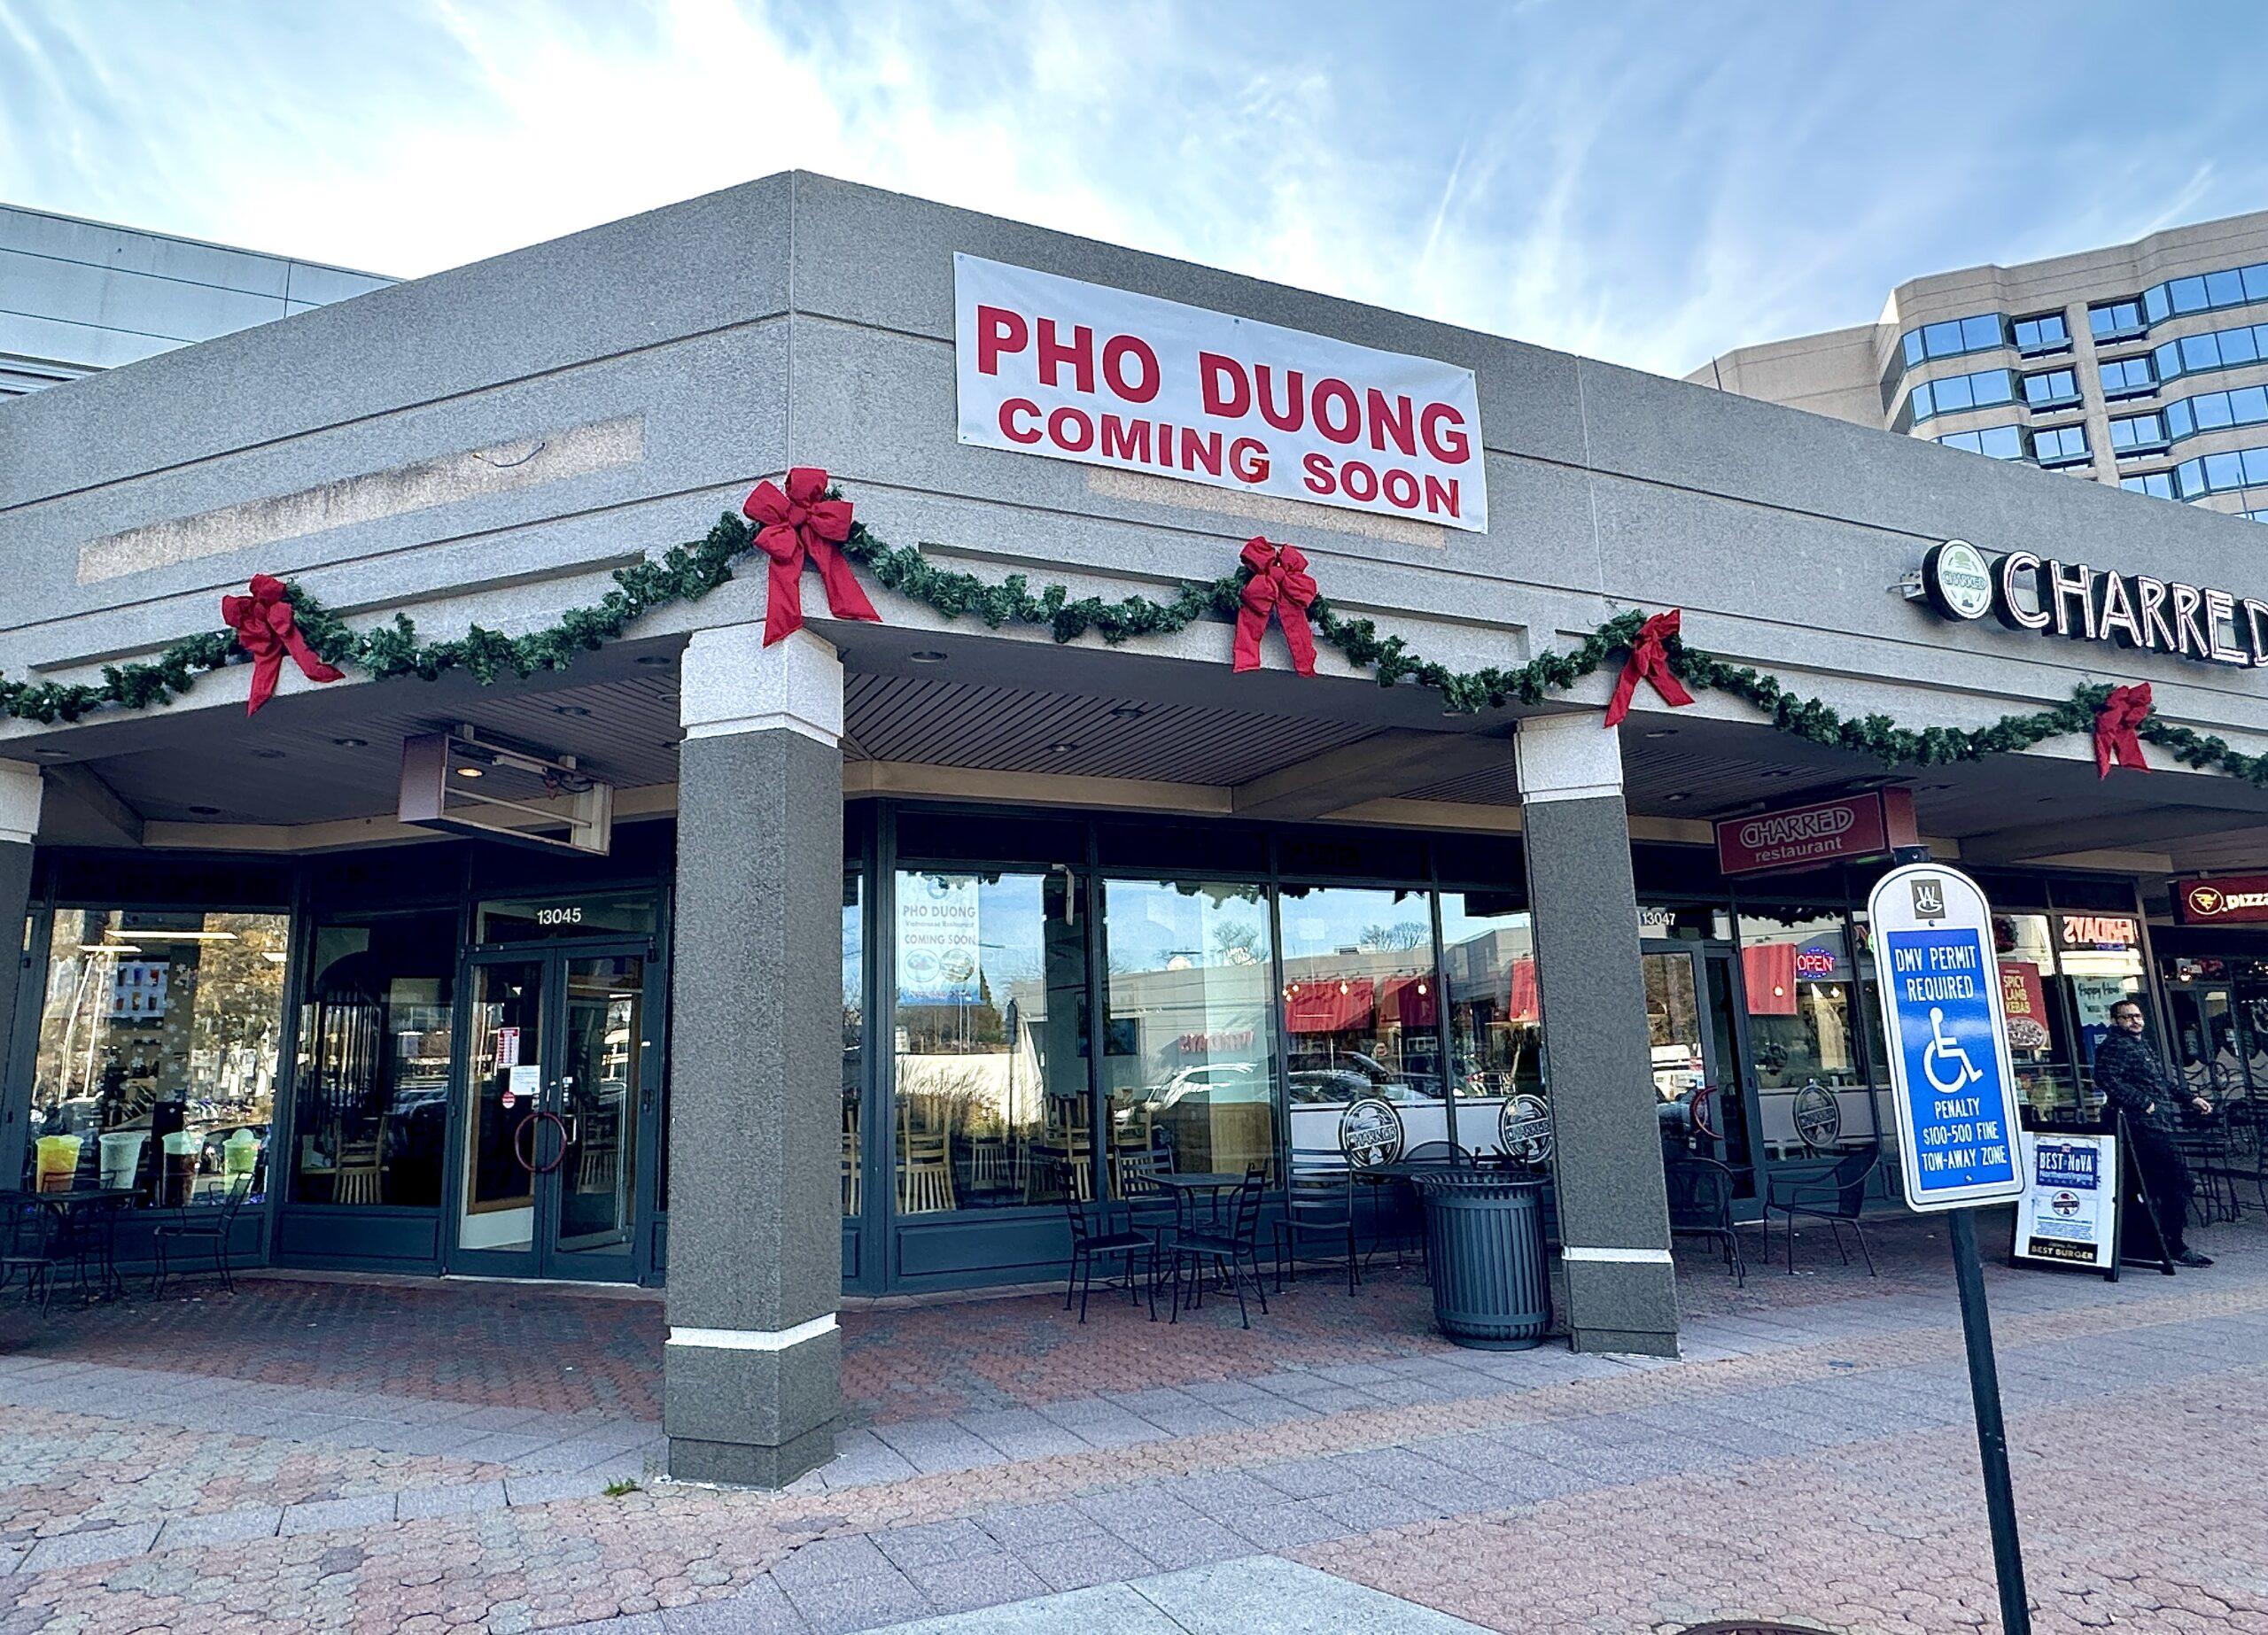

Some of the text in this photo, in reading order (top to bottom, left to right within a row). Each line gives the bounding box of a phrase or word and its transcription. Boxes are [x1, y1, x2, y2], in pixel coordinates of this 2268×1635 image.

[977, 304, 1471, 465] PHO DUONG
[998, 398, 1461, 519] COMING SOON
[2002, 550, 2268, 668] CHARRED
[1740, 807, 1854, 848] CHARRED
[1755, 836, 1843, 864] restaurant
[537, 908, 582, 926] 13045
[903, 905, 976, 918] PHO DUONG
[1642, 912, 1676, 926] 13047
[905, 934, 977, 946] COMING SOON
[1797, 954, 1835, 972] OPEN
[1894, 945, 1977, 972] DMV PERMIT
[1906, 975, 1974, 1002] REQUIRED
[1934, 1097, 1980, 1120] PENALTY
[1922, 1121, 1999, 1145] $100-500 FINE
[1922, 1145, 2008, 1172] TOW-AWAY ZONE
[2039, 1151, 2063, 1170] BEST
[2031, 1245, 2054, 1255] BEST
[2055, 1248, 2093, 1259] BURGER
